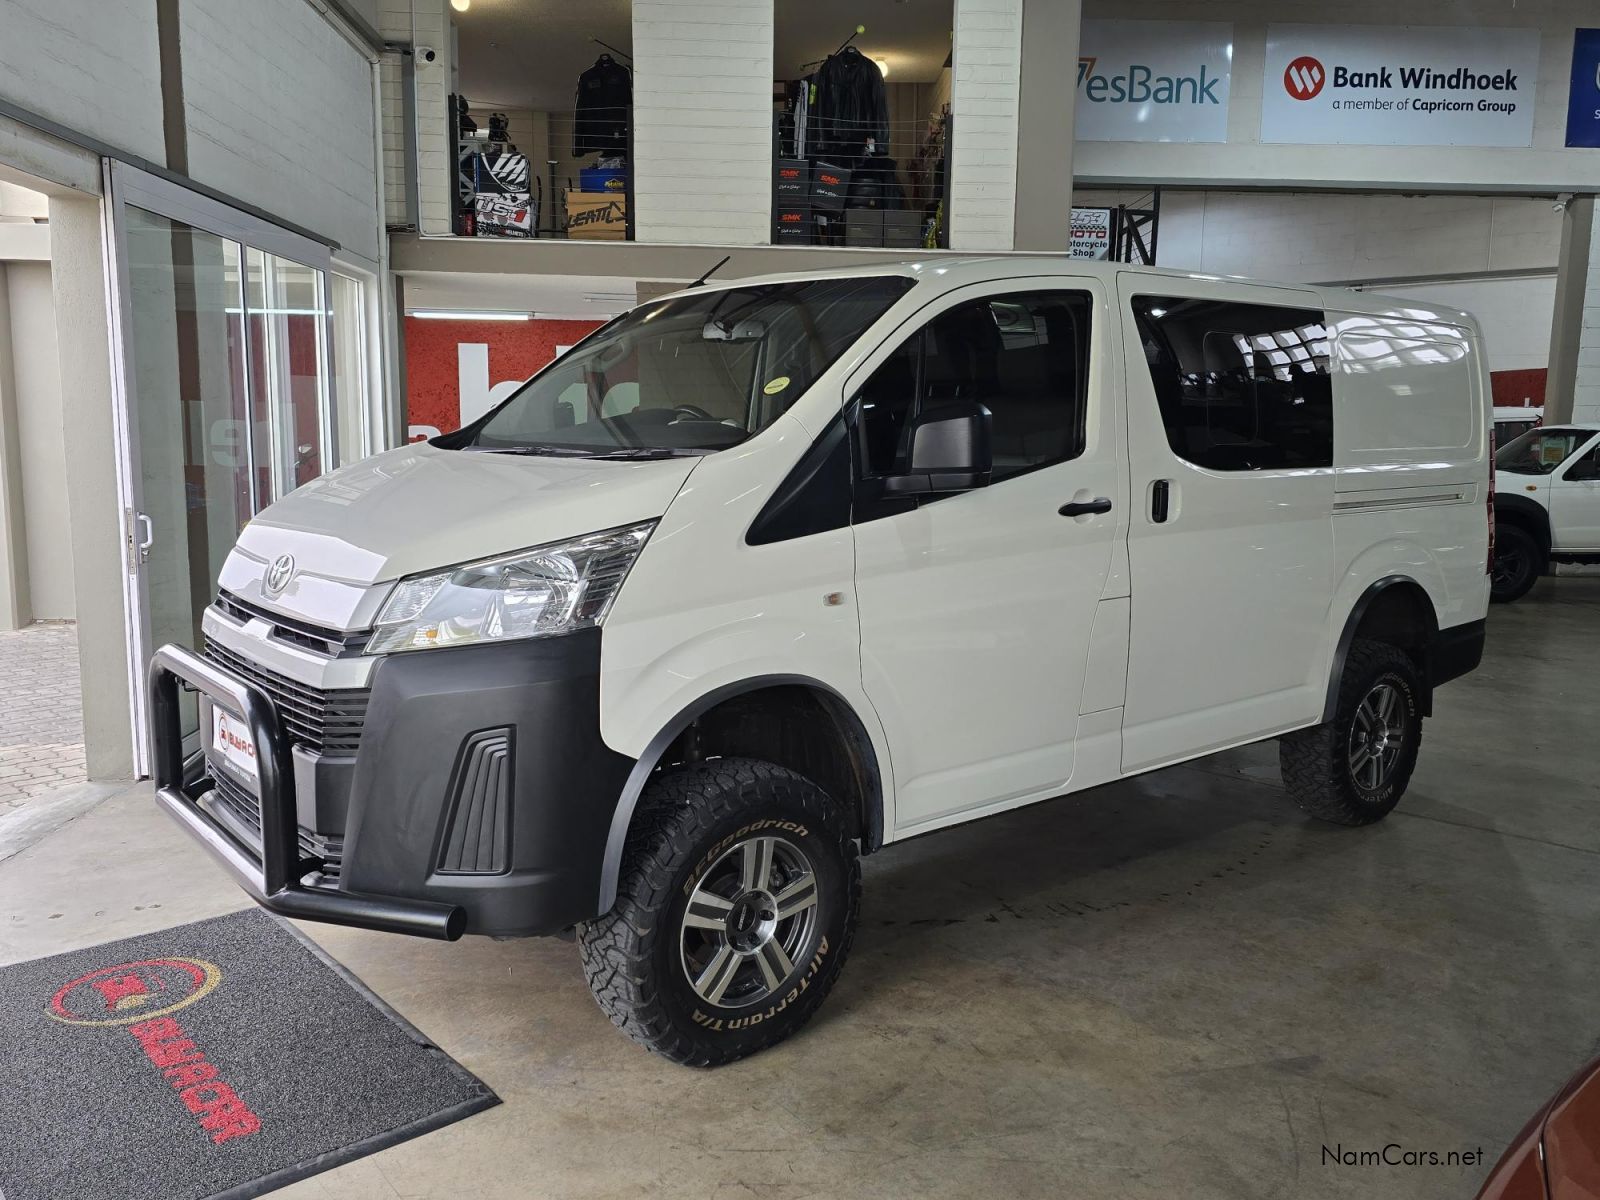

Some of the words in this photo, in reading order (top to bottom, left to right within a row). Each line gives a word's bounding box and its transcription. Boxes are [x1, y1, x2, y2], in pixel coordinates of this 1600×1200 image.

[1333, 66, 1393, 89] Bank
[1399, 67, 1518, 91] Windhoek
[1332, 100, 1341, 110] a
[1343, 98, 1393, 111] member
[1396, 98, 1410, 111] of
[1412, 99, 1474, 114] Capricorn
[1477, 99, 1516, 116] Group
[1069, 240, 1107, 249] otorcycle
[1073, 249, 1095, 258] Shop
[229, 731, 257, 758] BUYAC
